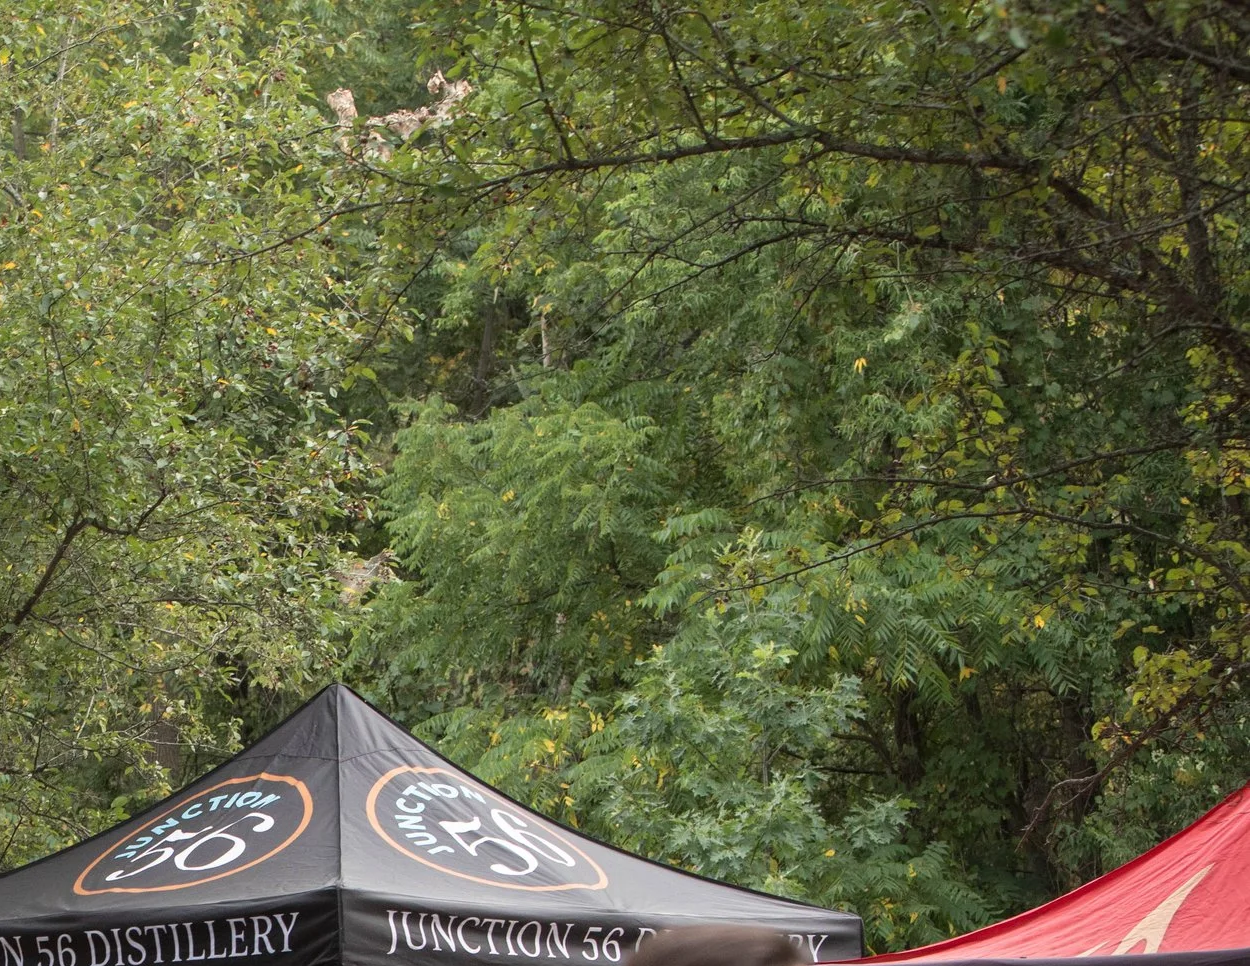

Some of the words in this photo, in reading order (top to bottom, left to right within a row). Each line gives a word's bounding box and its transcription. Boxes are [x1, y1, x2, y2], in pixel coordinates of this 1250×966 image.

[105, 812, 275, 881] 56
[114, 791, 281, 860] JUNCTION
[395, 782, 486, 855] JUNCTION
[438, 808, 576, 875] 56
[386, 910, 574, 959] JUNCTION
[582, 927, 625, 962] 56
